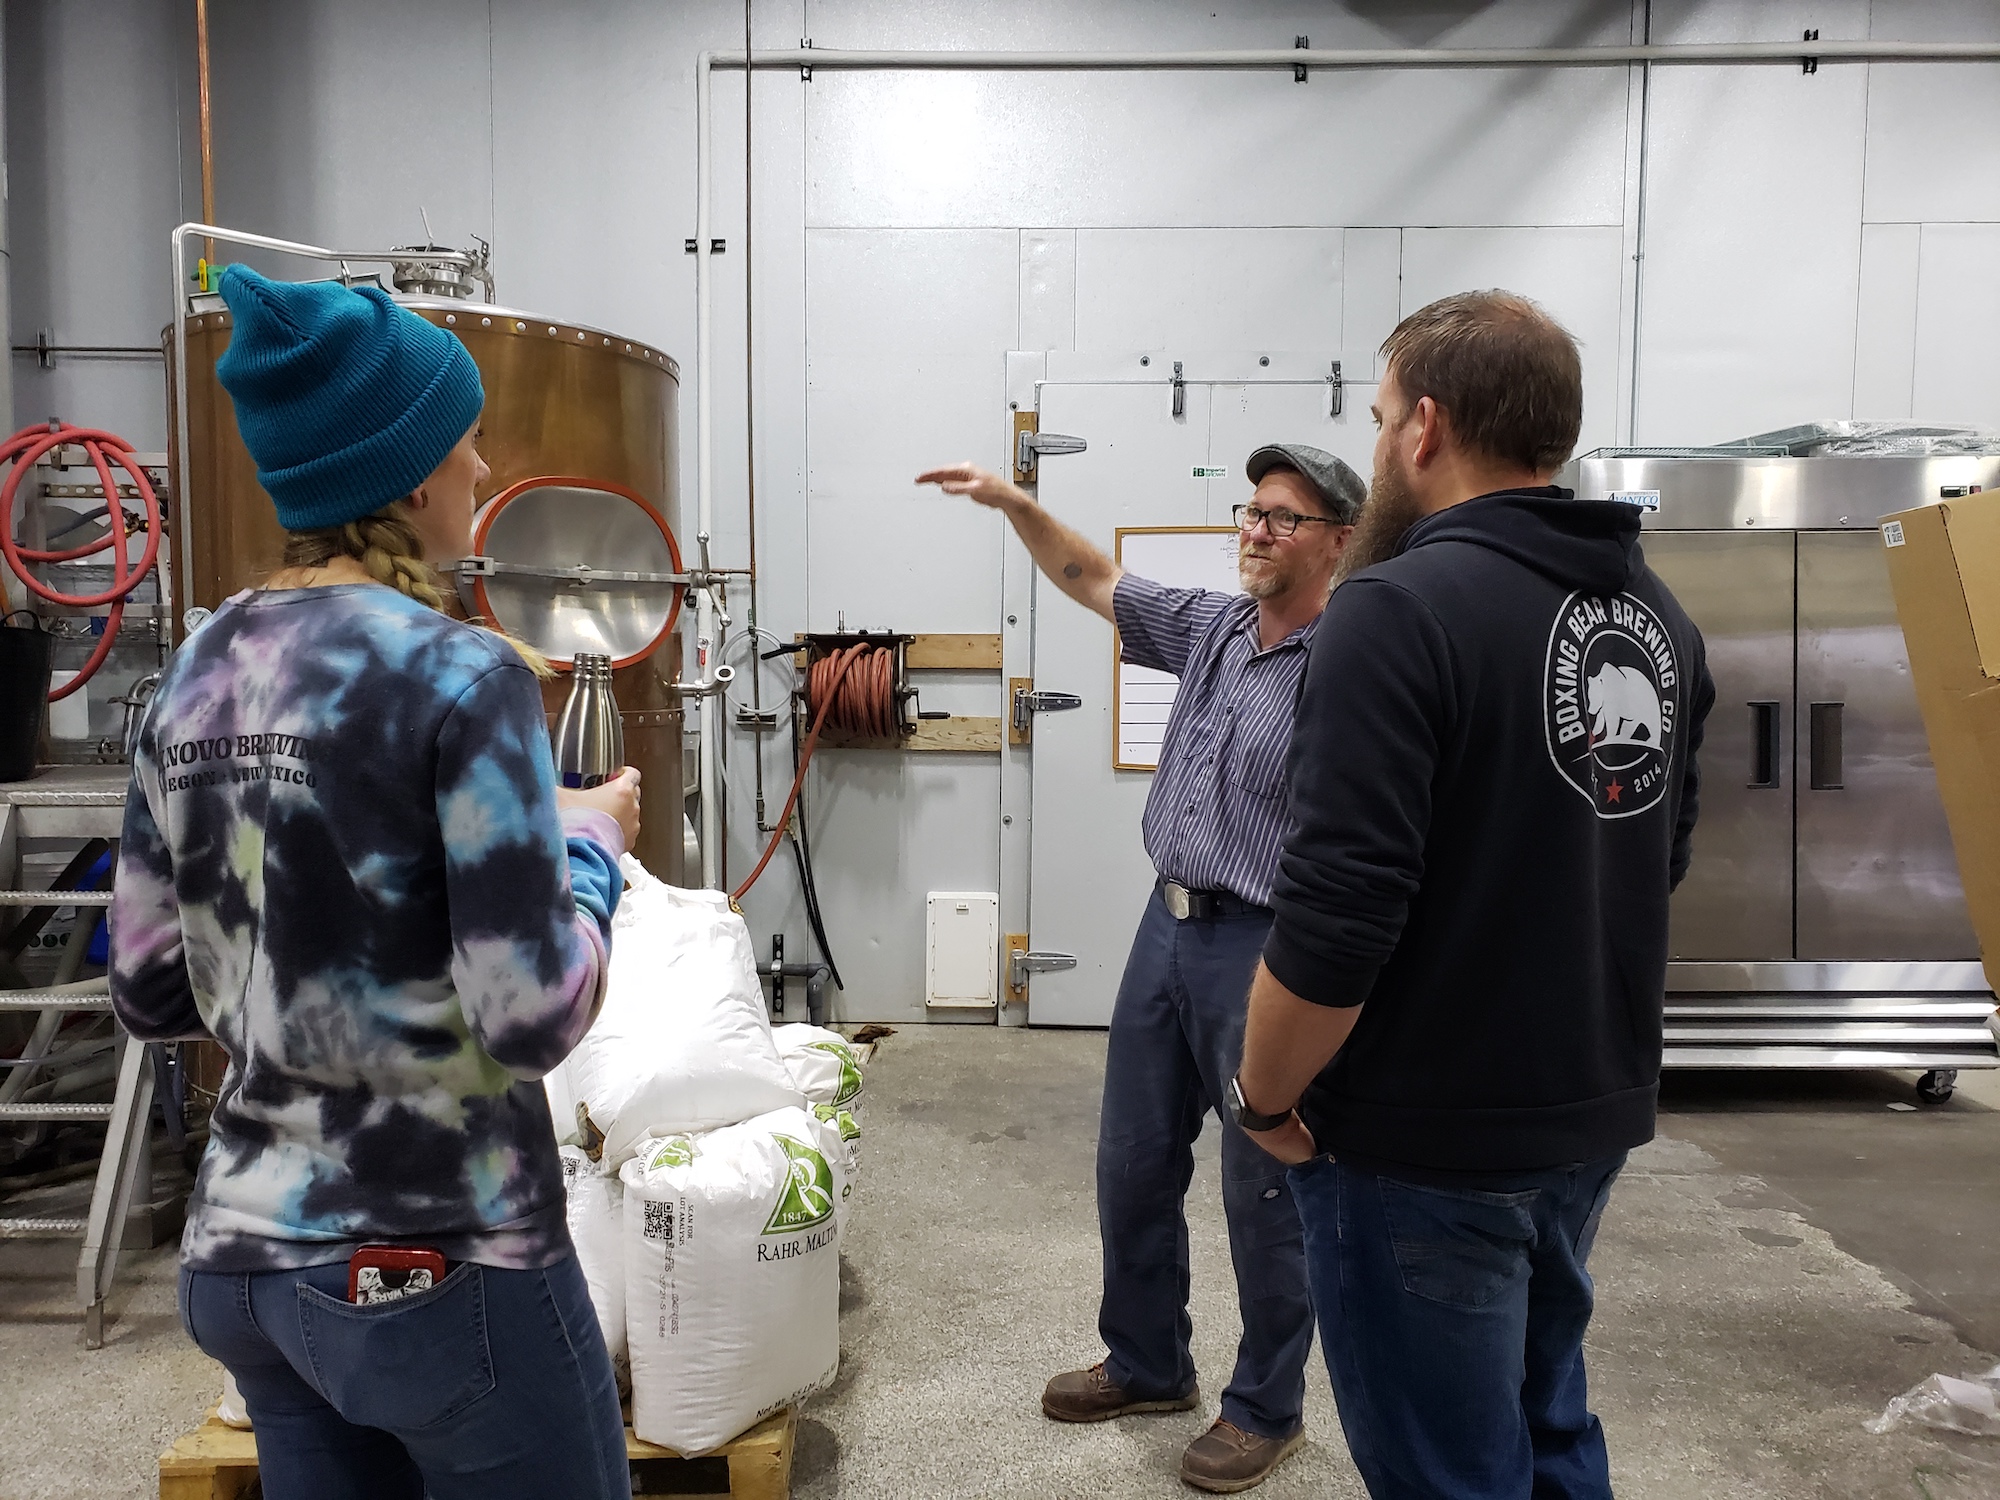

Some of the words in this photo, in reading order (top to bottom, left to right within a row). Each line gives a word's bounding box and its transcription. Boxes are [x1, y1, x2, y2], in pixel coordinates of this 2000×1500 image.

[1567, 597, 1609, 644] BEAR
[1611, 598, 1676, 690] BREWING
[1554, 638, 1587, 744] BOXING
[1661, 700, 1675, 734] CO
[166, 737, 232, 768] NOVO
[168, 771, 216, 792] EGON
[266, 765, 317, 788] EXICO
[1633, 763, 1662, 793] 2014
[782, 1209, 807, 1223] 1847
[757, 1241, 804, 1262] RAHR
[805, 1218, 838, 1253] MALTIN
